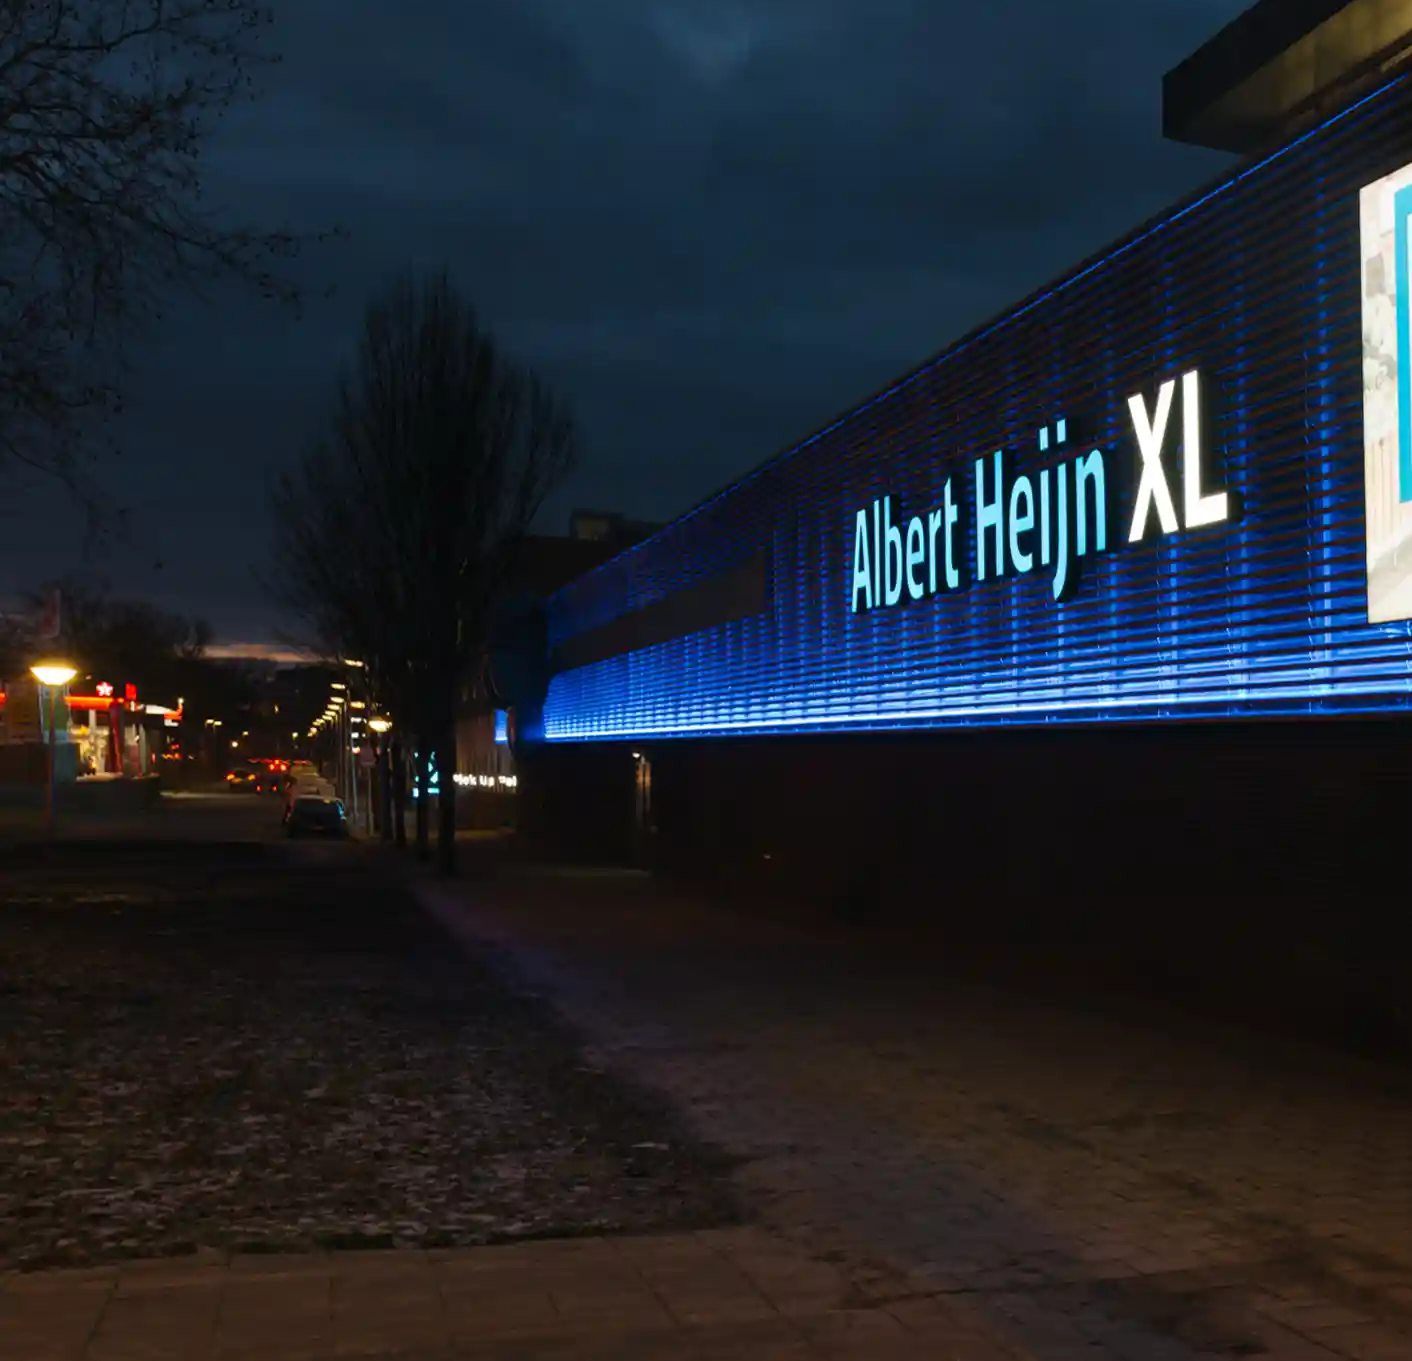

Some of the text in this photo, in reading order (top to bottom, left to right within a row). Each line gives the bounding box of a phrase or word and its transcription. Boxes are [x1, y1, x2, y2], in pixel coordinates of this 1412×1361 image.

[851, 369, 1228, 613] Albert Heijn XL
